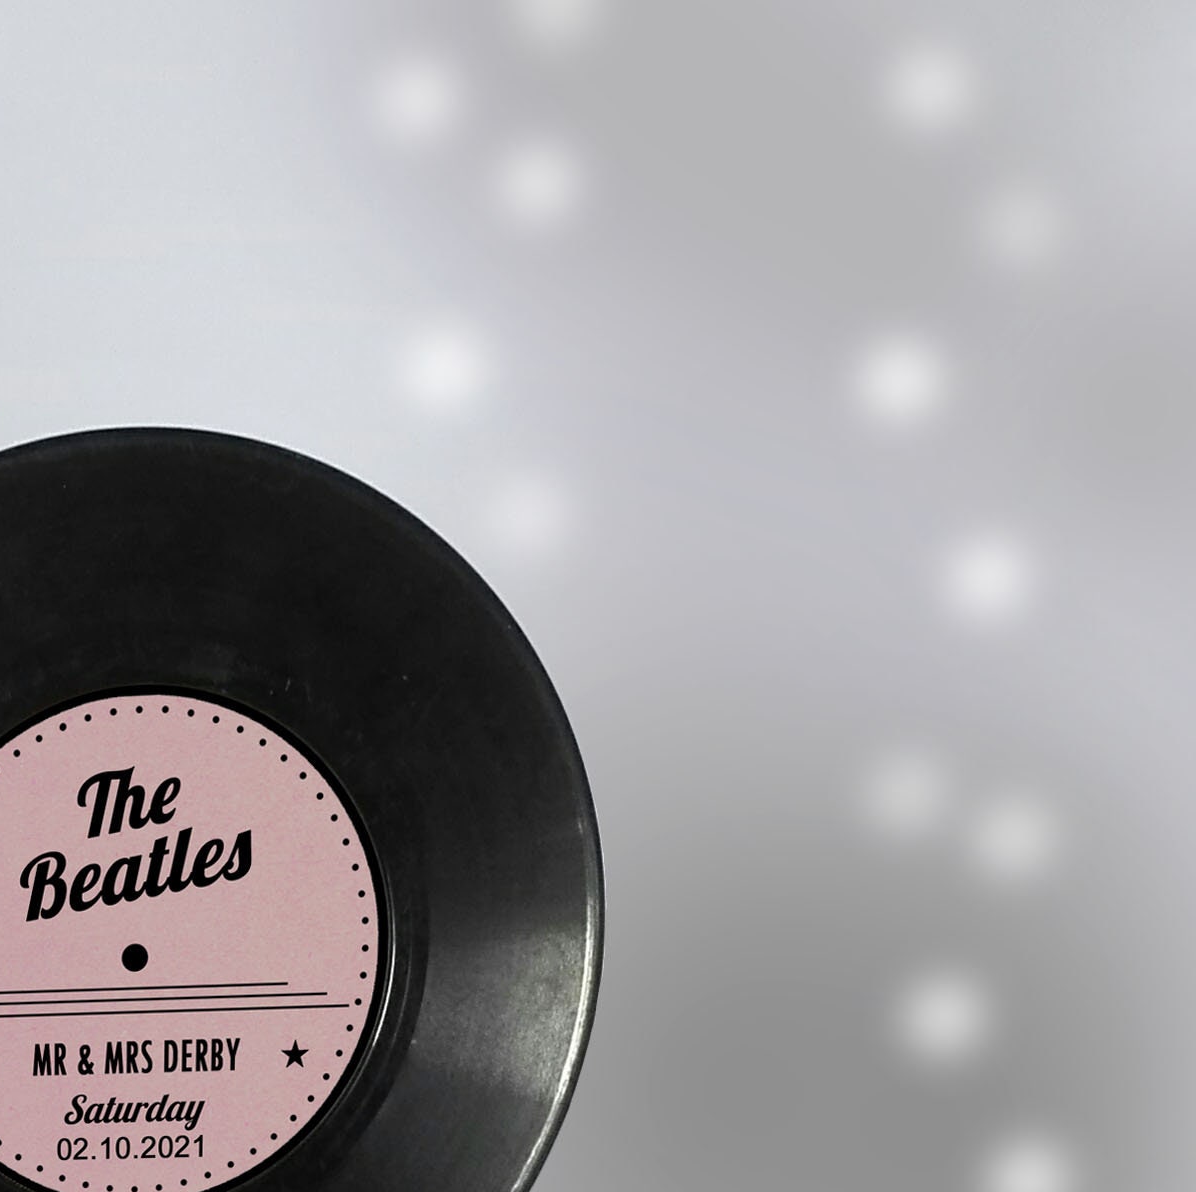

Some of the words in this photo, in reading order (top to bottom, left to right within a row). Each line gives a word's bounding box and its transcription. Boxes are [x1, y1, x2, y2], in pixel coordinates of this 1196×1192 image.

[77, 766, 181, 838] The
[20, 827, 252, 921] Beatles
[33, 1043, 66, 1076] MR
[78, 1044, 95, 1076] &
[105, 1040, 153, 1074] MRS
[164, 1038, 241, 1072] DERBY
[64, 1094, 206, 1131] Saturday
[57, 1135, 205, 1160] 02.10.2021
